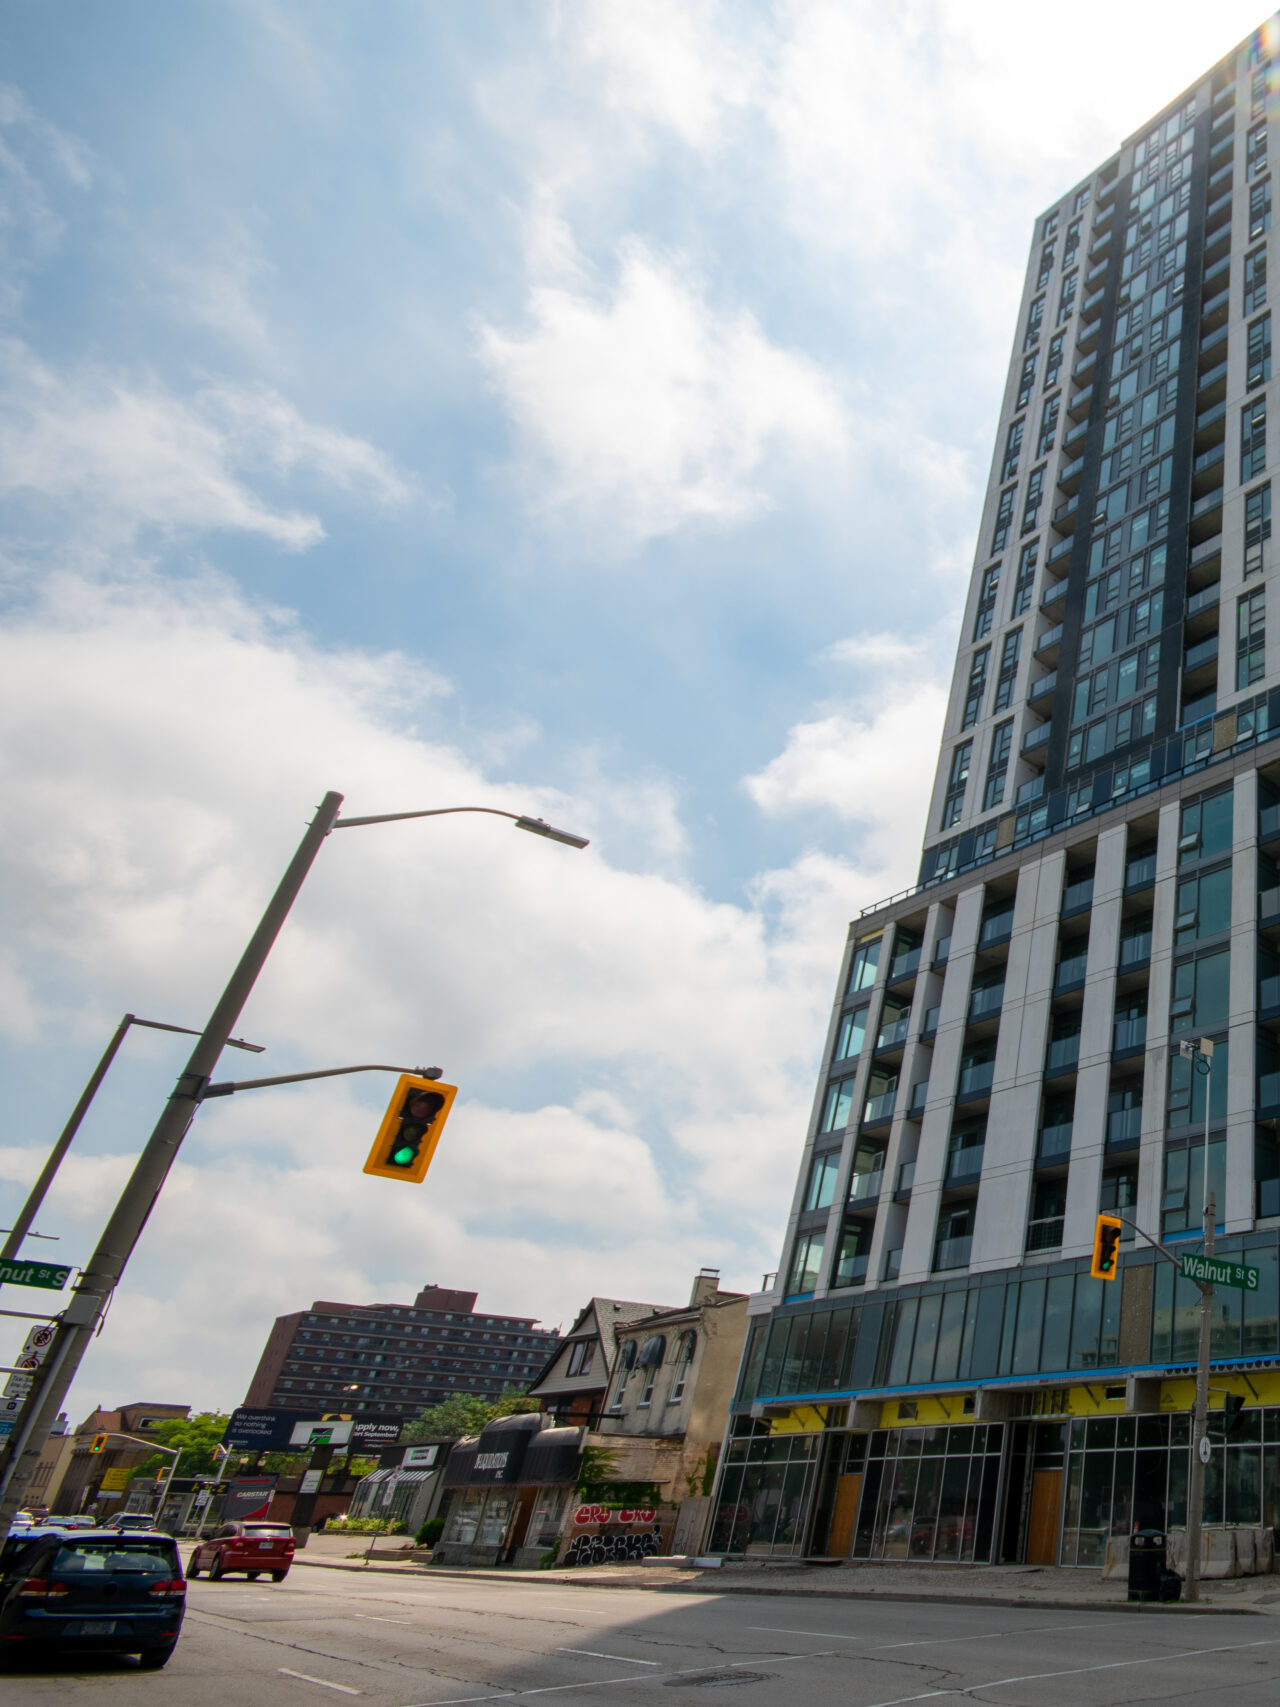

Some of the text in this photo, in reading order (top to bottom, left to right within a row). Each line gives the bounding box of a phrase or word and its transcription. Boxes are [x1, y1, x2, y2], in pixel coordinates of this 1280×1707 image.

[1183, 1256, 1257, 1288] Walnut St S
[38, 1269, 51, 1279] St
[52, 1270, 69, 1287] S
[243, 1421, 267, 1429] nothing
[378, 1424, 400, 1433] now,
[237, 1490, 268, 1498] CARSTAR
